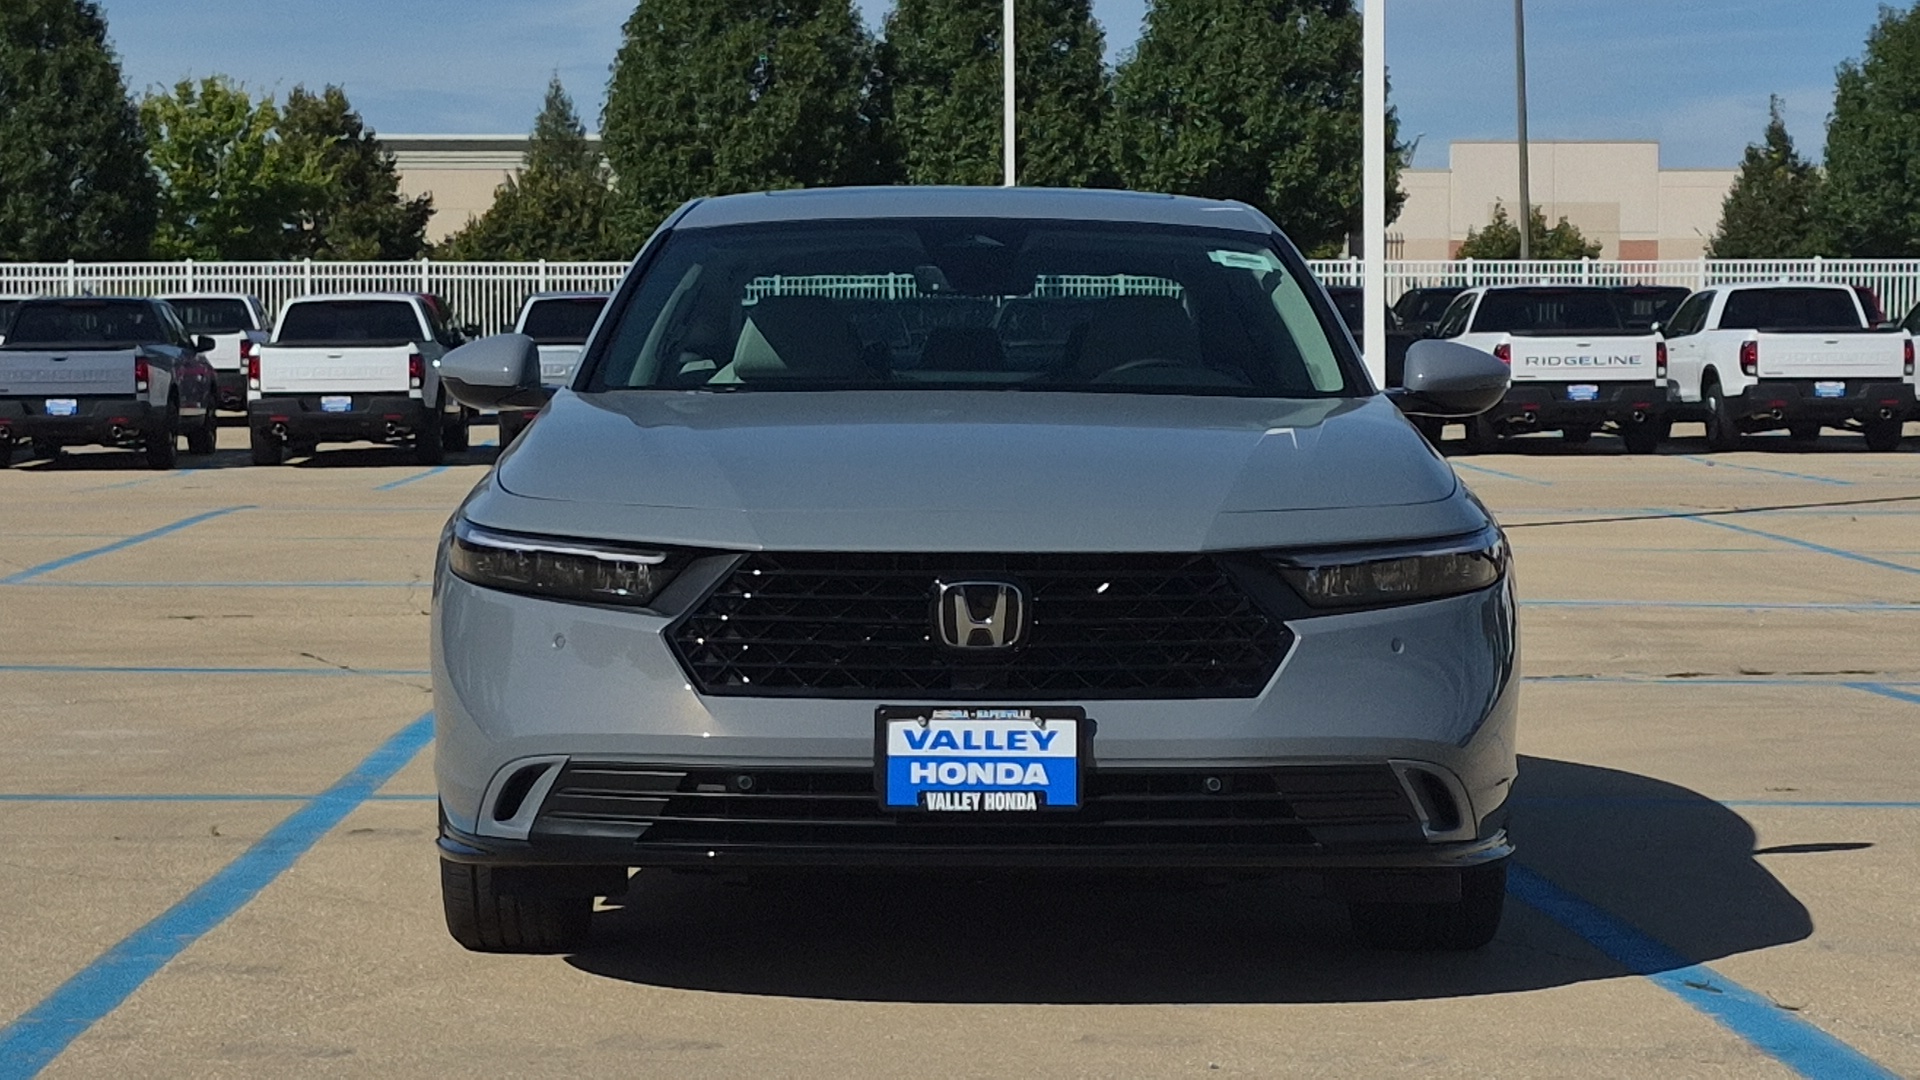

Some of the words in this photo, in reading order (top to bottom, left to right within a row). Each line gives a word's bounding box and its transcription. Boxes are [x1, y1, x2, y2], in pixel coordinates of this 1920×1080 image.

[1525, 354, 1643, 366] RIDGELINE
[903, 729, 1058, 751] VALLEY
[910, 761, 1050, 785] HONDA
[926, 791, 981, 811] VALLEY
[984, 791, 1038, 811] HONDA
